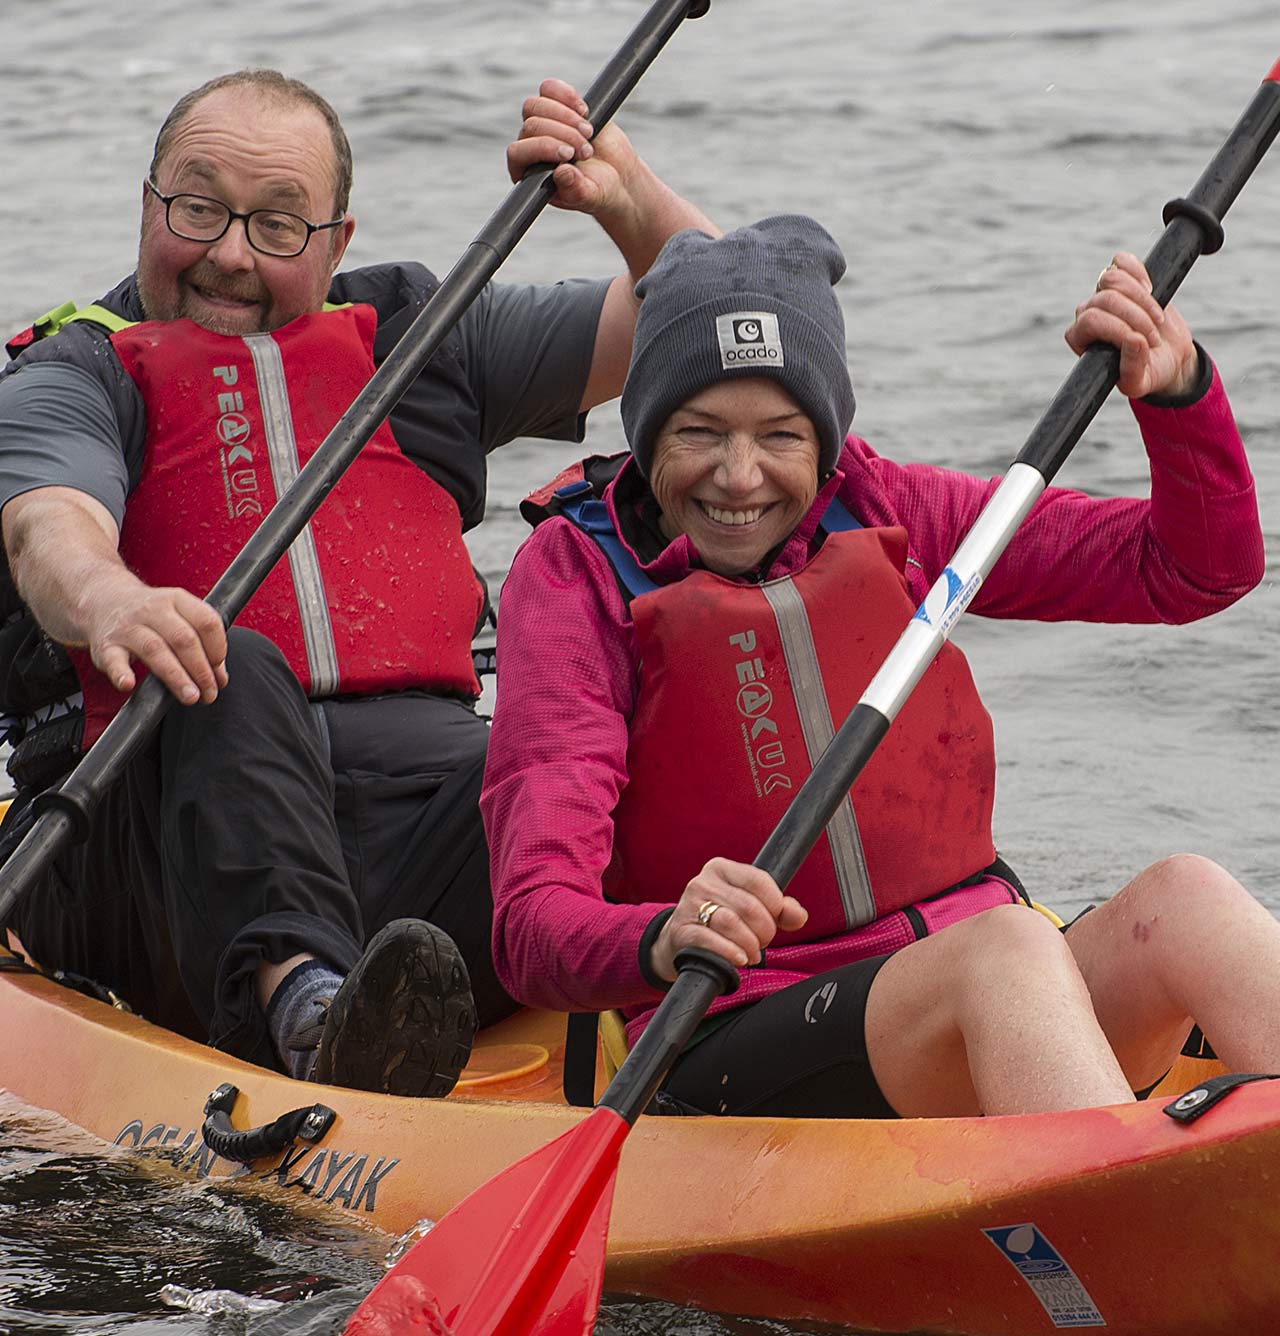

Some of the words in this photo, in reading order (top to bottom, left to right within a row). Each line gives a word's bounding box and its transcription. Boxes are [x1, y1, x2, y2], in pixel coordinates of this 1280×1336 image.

[726, 345, 778, 361] ocado
[741, 723, 762, 798] www.peakuk.com
[276, 1144, 400, 1213] KAYAK
[1031, 1279, 1081, 1292] CANOE
[1040, 1293, 1091, 1307] KAYAK
